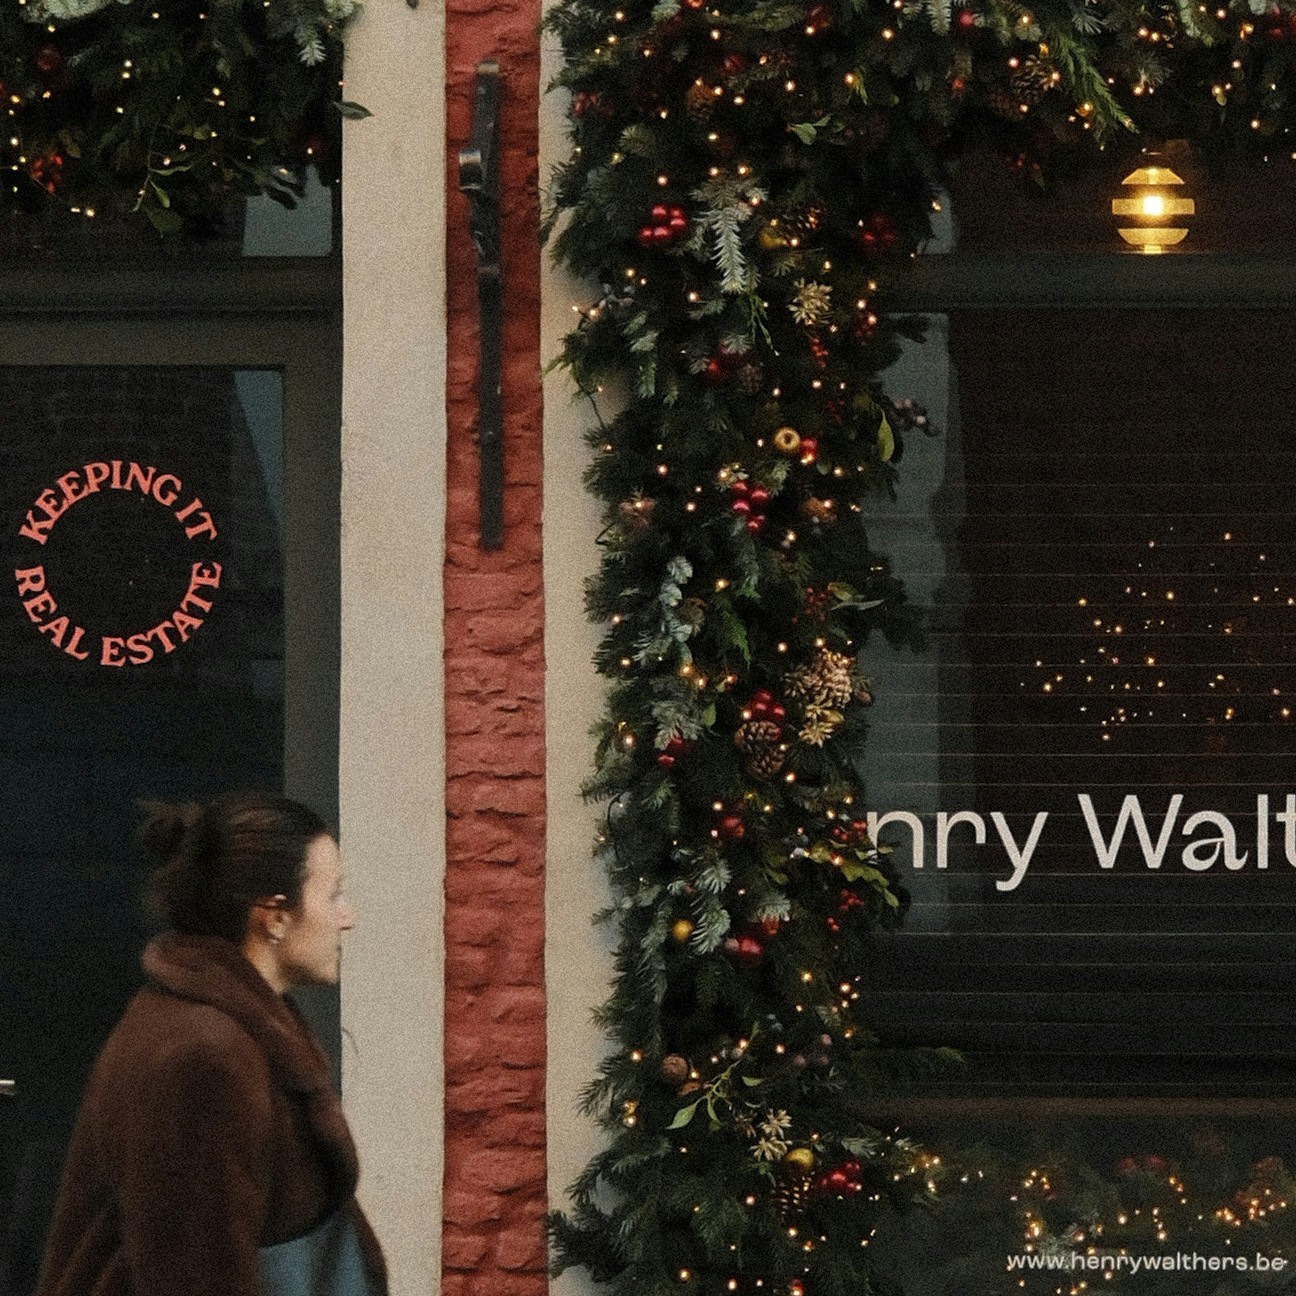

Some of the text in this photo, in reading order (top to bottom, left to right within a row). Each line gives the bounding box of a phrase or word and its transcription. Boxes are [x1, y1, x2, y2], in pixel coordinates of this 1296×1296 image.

[18, 459, 218, 545] KEEPING IT
[14, 561, 223, 667] REAL ESTATE
[866, 809, 1048, 892] nry
[1006, 1251, 1286, 1275] www.henrywalthers.be
